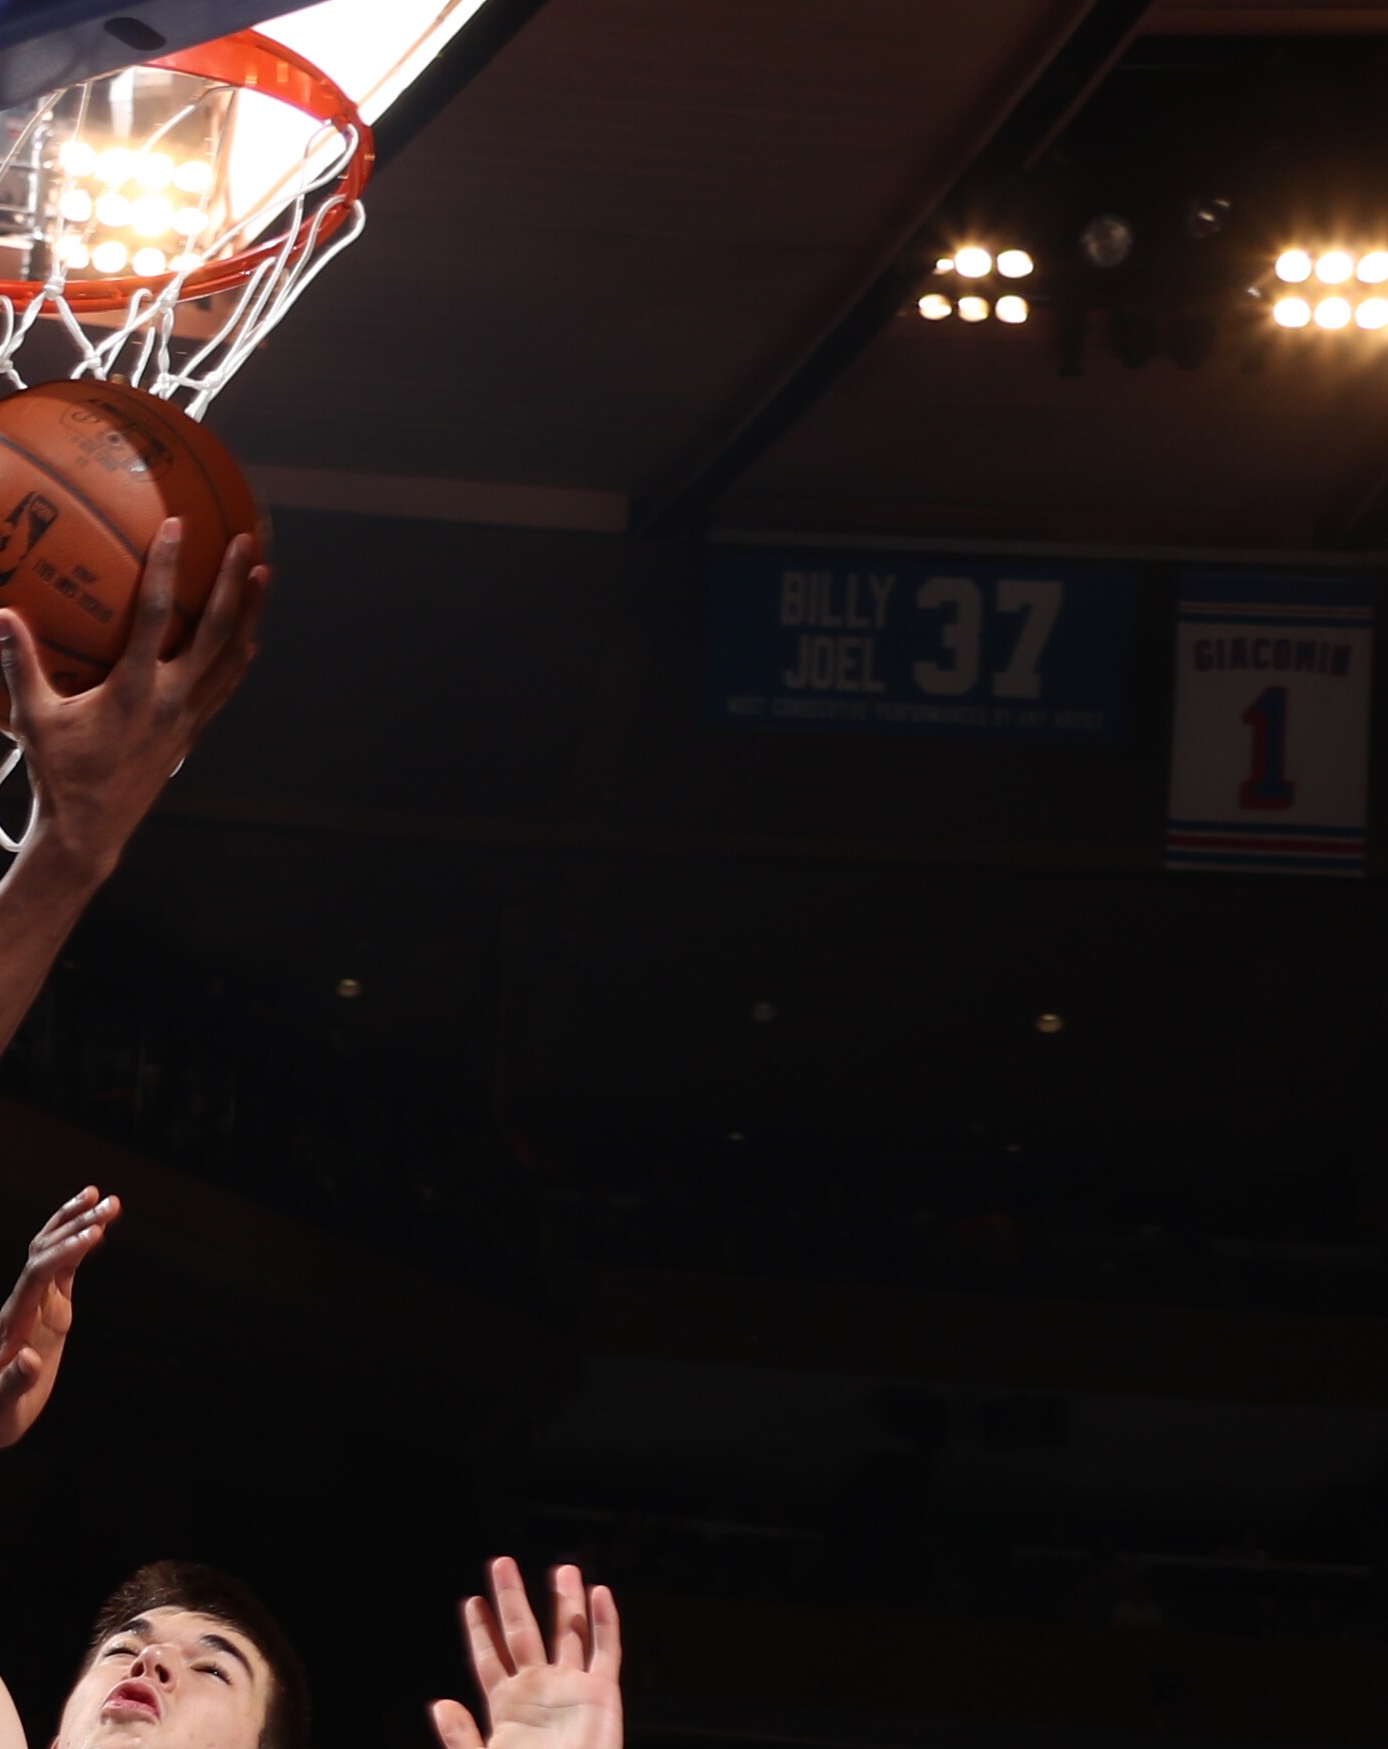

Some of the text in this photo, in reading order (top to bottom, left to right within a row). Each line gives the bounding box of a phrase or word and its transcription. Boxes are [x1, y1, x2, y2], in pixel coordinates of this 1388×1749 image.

[780, 570, 896, 630] BILLY
[782, 633, 887, 693] JOEL
[912, 576, 1064, 699] 37
[1193, 637, 1352, 677] GIACOMIN
[1237, 685, 1295, 811] 1
